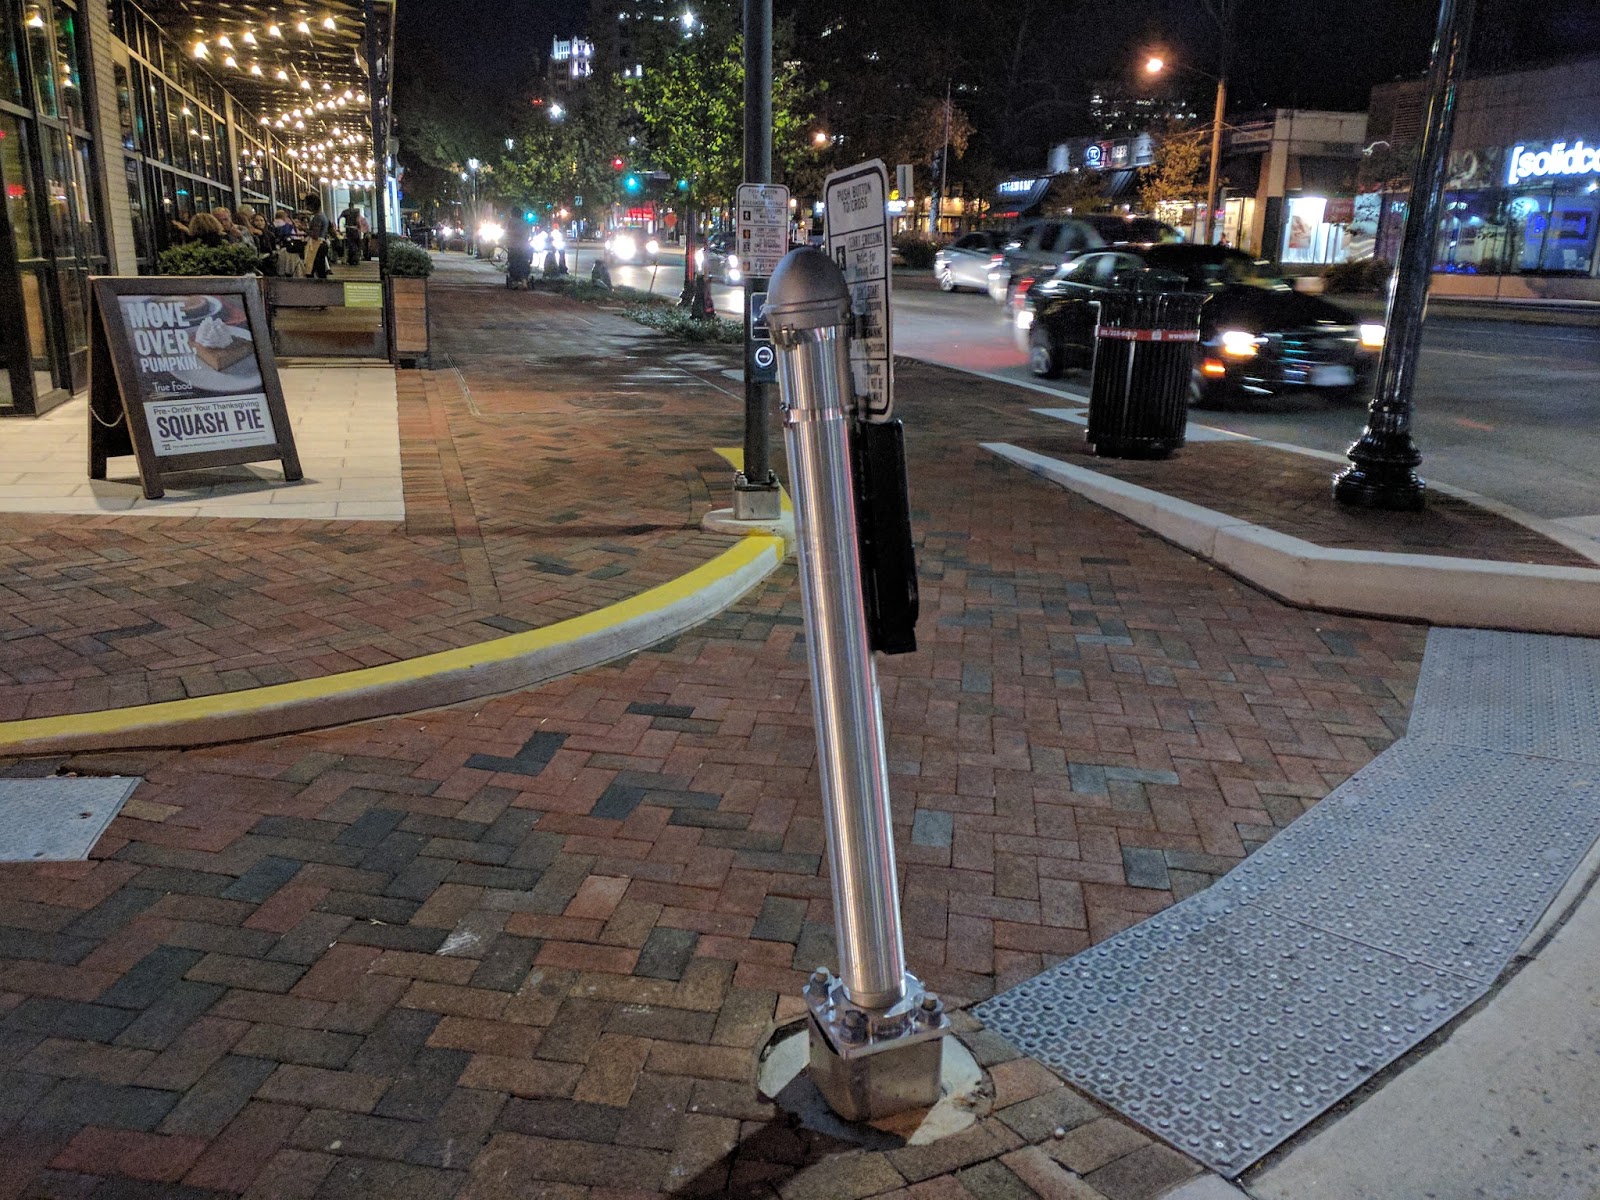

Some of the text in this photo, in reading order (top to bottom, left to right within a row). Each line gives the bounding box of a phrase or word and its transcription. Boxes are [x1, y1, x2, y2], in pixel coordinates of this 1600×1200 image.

[837, 181, 872, 202] PUSH BUTTON
[843, 196, 868, 213] TO CROSS
[128, 301, 190, 329] MOVE
[134, 329, 197, 356] OVER,
[140, 355, 202, 373] PUMPKIN.
[152, 380, 193, 392] True Food
[213, 401, 260, 411] Thanksgiving
[156, 409, 265, 441] SQUASH PIE
